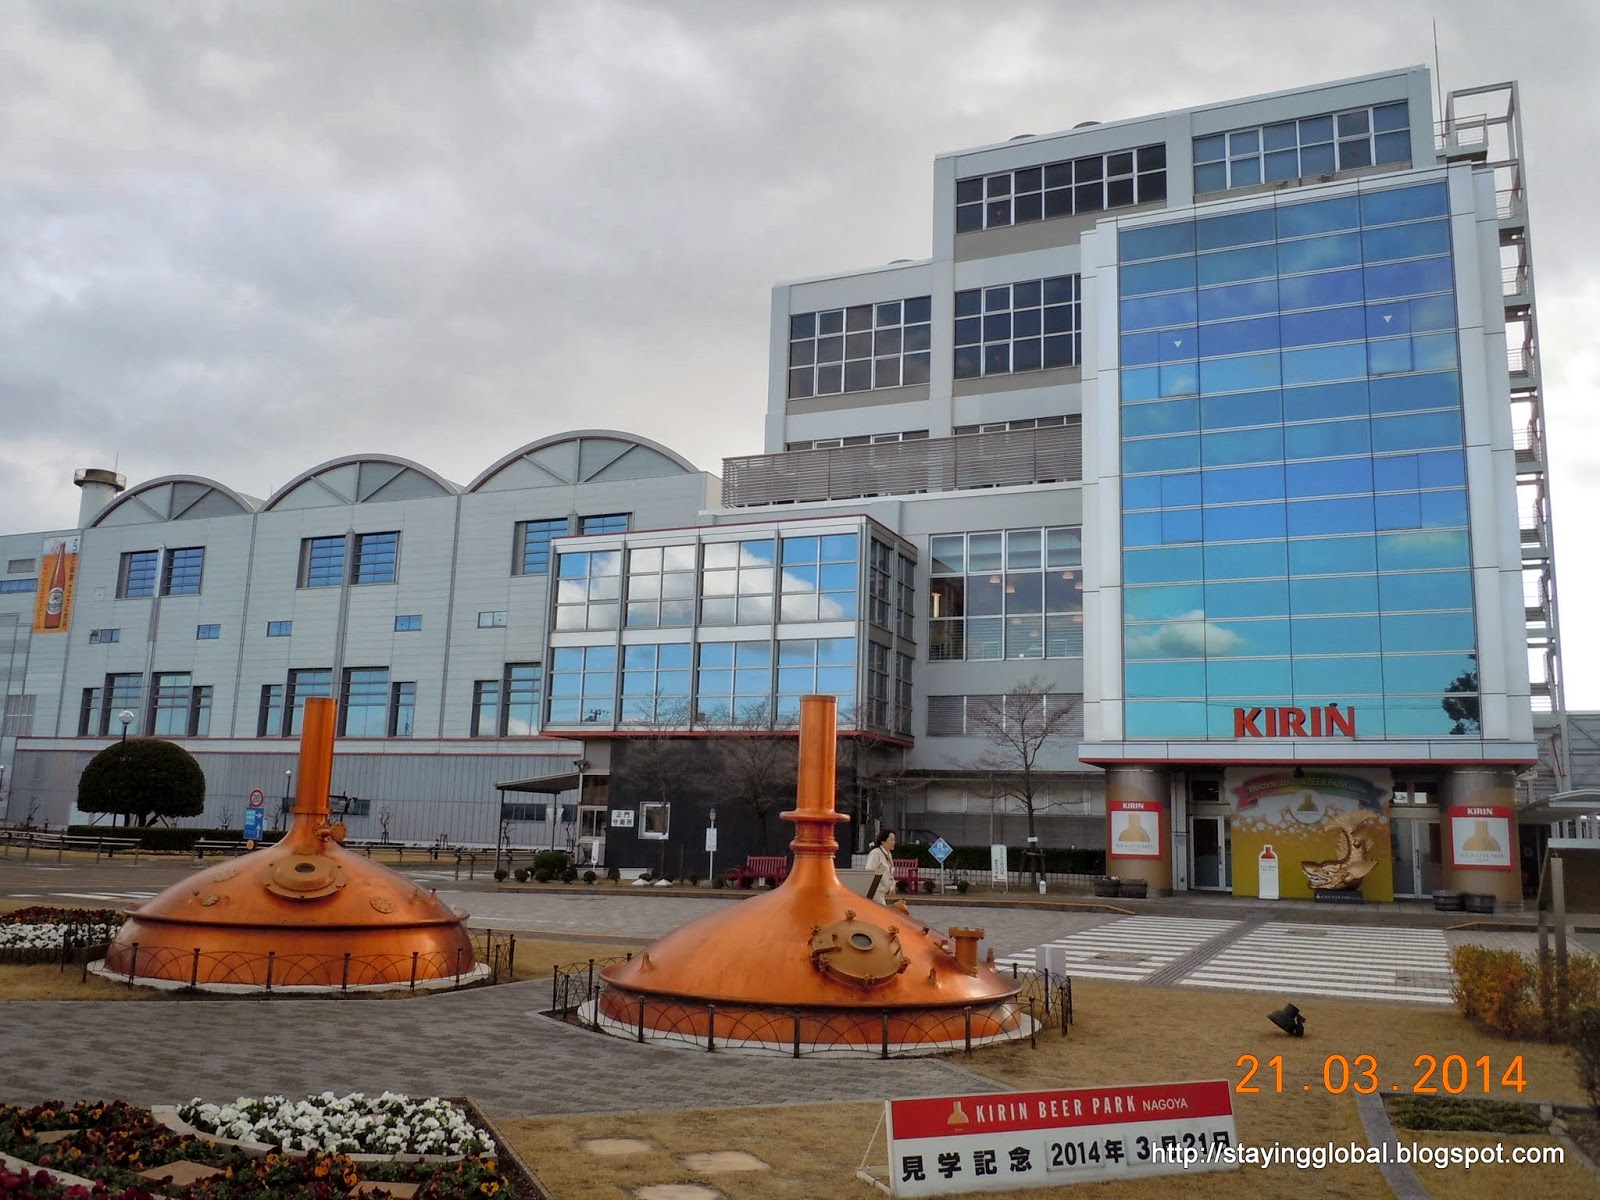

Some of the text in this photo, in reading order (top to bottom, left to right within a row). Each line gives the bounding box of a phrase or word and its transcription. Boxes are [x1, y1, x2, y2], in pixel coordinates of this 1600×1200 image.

[1234, 706, 1356, 738] KIRIN
[1307, 777, 1327, 786] BEER
[1467, 807, 1493, 815] KIRIN
[976, 1095, 1188, 1123] KIRIN BEER PARK NAGOYA
[902, 1146, 1032, 1182] 見学記念
